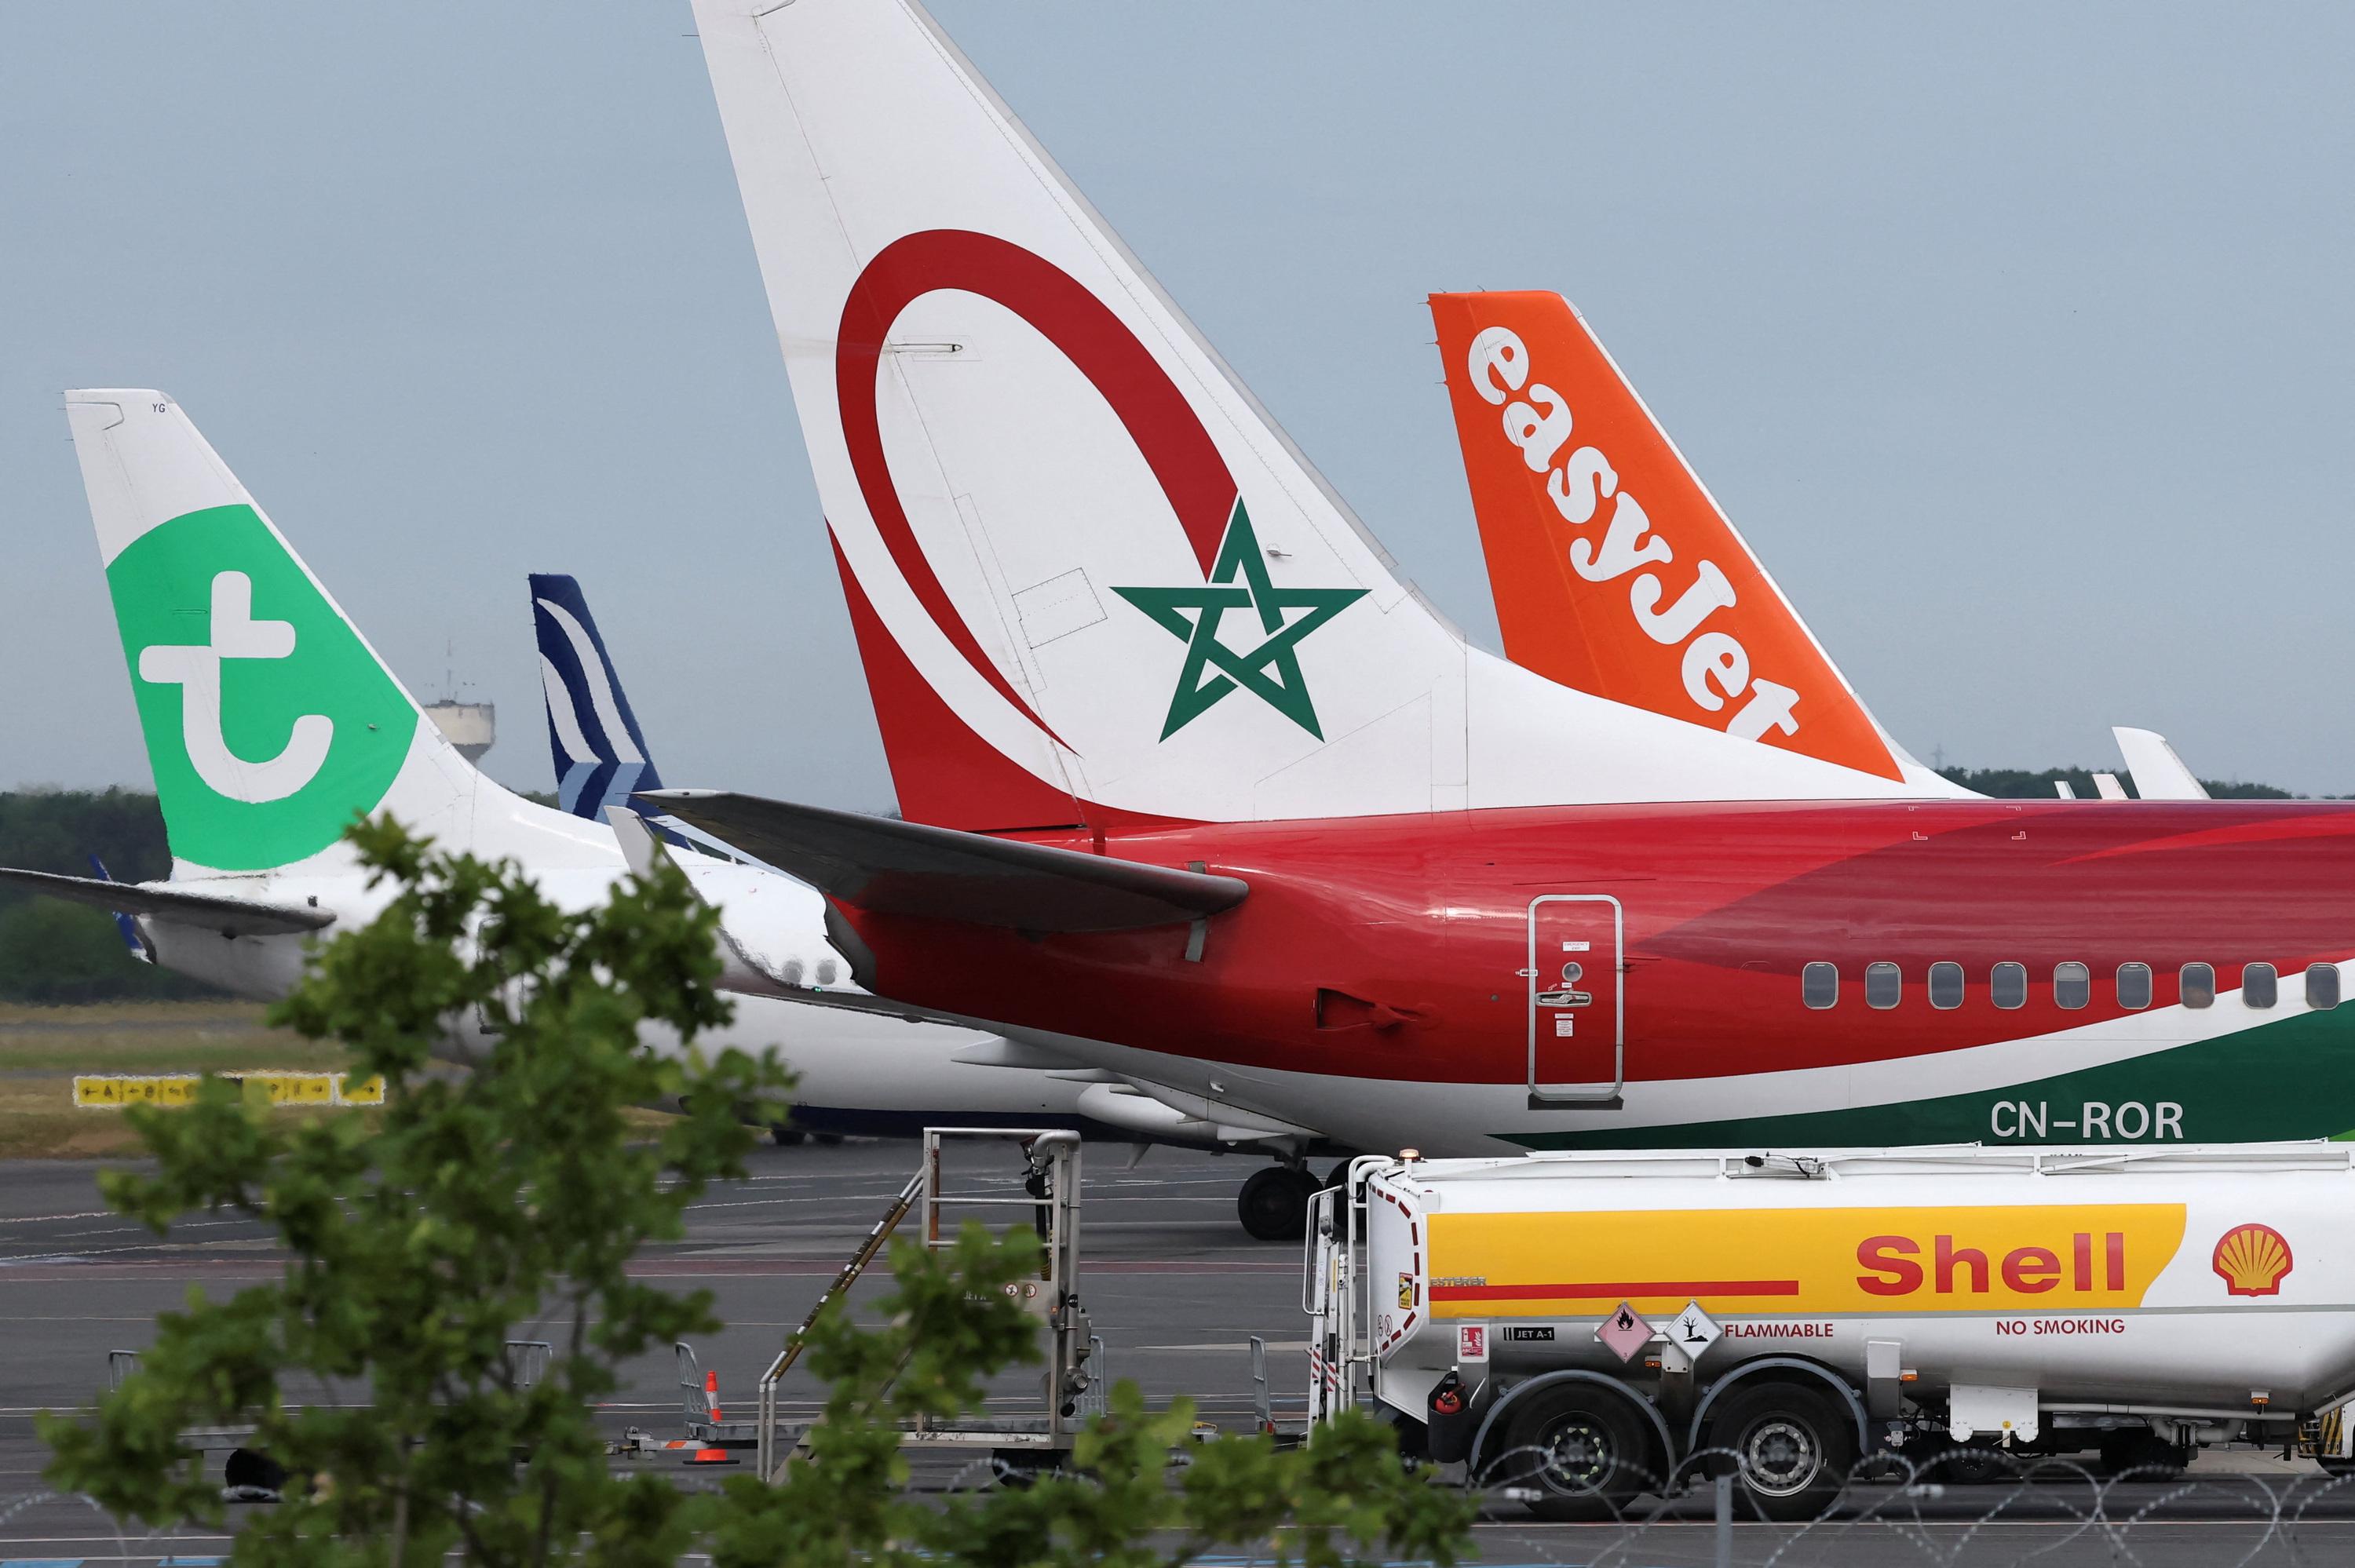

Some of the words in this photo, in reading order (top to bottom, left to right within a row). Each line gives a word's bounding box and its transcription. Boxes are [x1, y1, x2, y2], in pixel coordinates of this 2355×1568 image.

[152, 403, 166, 413] YG
[1468, 326, 1801, 742] easyJet
[1991, 1101, 2184, 1139] CN-ROR
[1856, 1232, 2125, 1296] Shell
[1725, 1323, 1834, 1338] FLAMMABLE
[1996, 1321, 2026, 1335] NO
[2033, 1319, 2125, 1335] SMOKING
